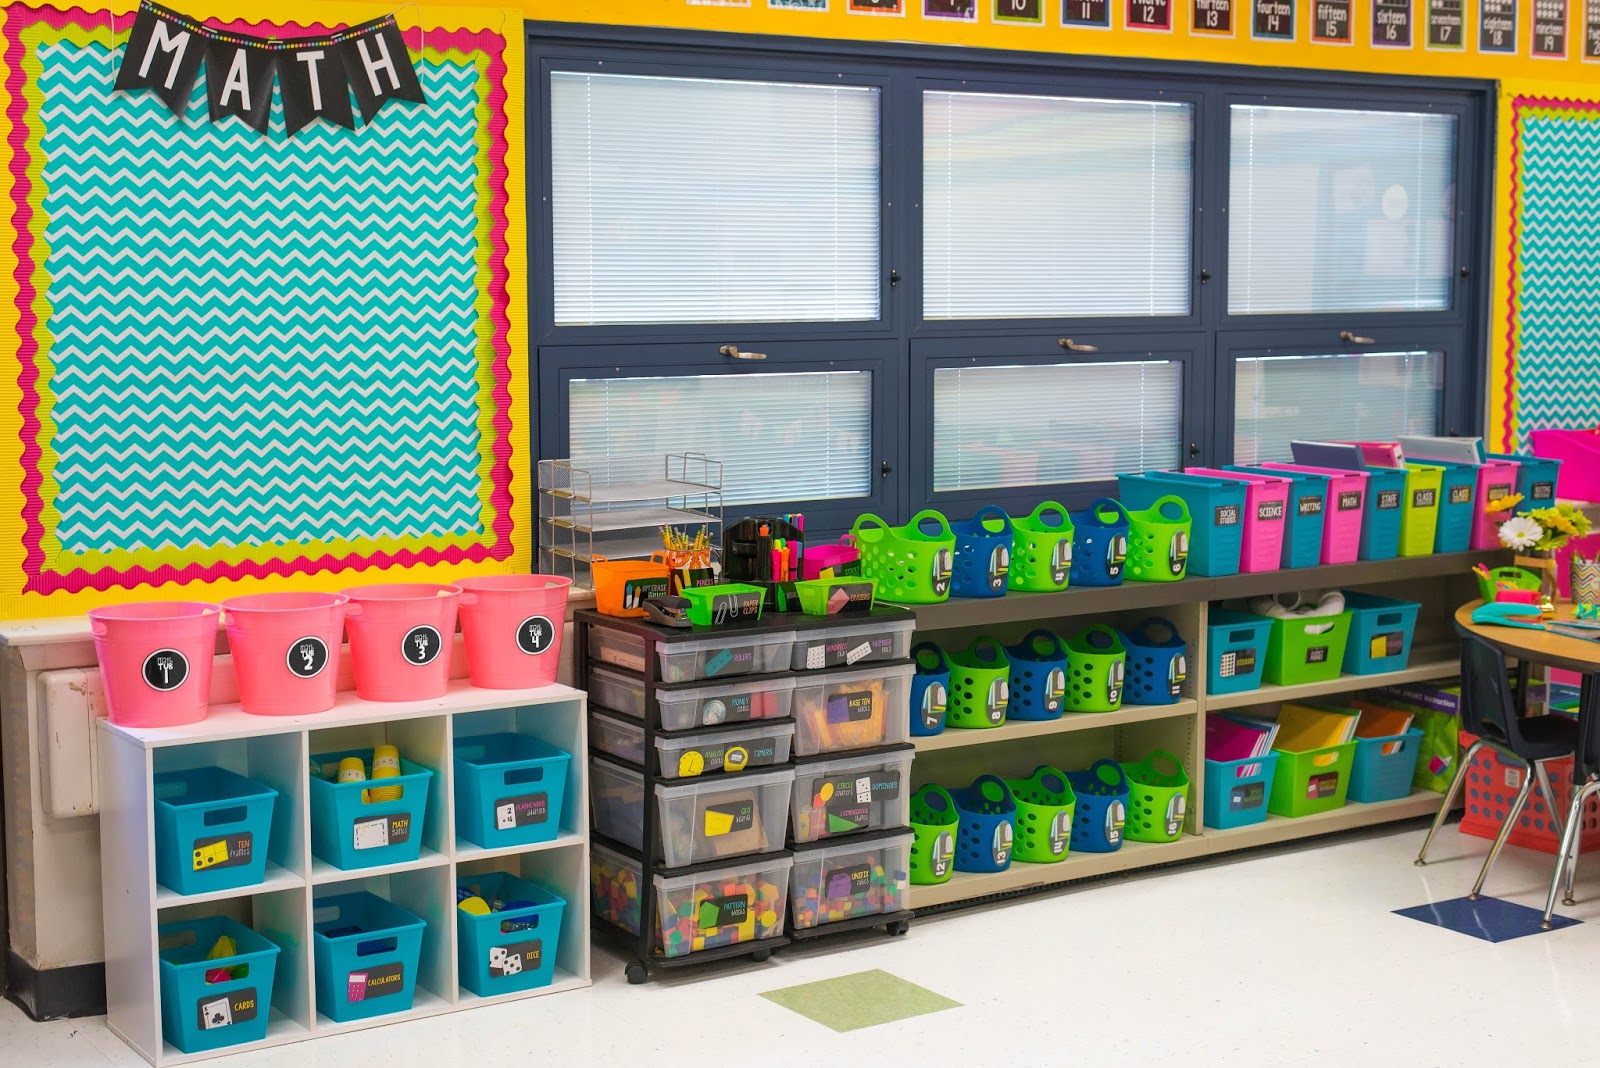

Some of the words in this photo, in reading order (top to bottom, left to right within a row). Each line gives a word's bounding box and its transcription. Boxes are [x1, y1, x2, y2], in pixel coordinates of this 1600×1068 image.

[1082, 2, 1090, 19] 11
[1257, 1, 1290, 16] fourteen
[1318, 4, 1347, 21] fifteen
[1143, 5, 1155, 23] 12
[1377, 9, 1406, 26] sixteen
[1206, 13, 1218, 27] 13
[1267, 15, 1279, 31] 14
[1430, 13, 1461, 26] seventeen
[1326, 21, 1337, 36] 15
[1483, 15, 1513, 35] eighteen
[1536, 23, 1563, 36] nineteen
[1386, 25, 1397, 40] 16
[1440, 27, 1450, 41] 17
[1492, 31, 1503, 46] 18
[1544, 35, 1554, 50] 19
[138, 20, 401, 111] MATH
[1381, 493, 1397, 504] STAFF
[1416, 491, 1433, 501] CLASS
[1452, 488, 1469, 499] CLASS
[1299, 502, 1322, 513] WRITING
[1342, 497, 1357, 508] MATH
[1219, 509, 1236, 518] SOCIAL
[1258, 506, 1282, 518] SCIENCE
[1219, 516, 1237, 525] STUDIES
[1110, 566, 1119, 575] 5
[1055, 572, 1064, 581] 4
[651, 584, 667, 592] ERASE
[696, 579, 714, 587] PENCILS
[936, 582, 946, 592] 2
[993, 579, 1002, 587] 3
[850, 593, 871, 602] ERASERS
[743, 600, 759, 608] PAPER
[743, 606, 758, 615] CLIPS
[529, 624, 542, 632] math
[532, 635, 540, 648] 4
[872, 639, 892, 648] NUMBER
[300, 644, 315, 652] math
[418, 645, 426, 660] 3
[301, 650, 315, 658] TUB
[734, 653, 752, 662] RULERS
[157, 656, 174, 664] math
[303, 655, 313, 671] 2
[1236, 657, 1255, 667] STICKERS
[164, 669, 169, 684] 1
[1172, 685, 1181, 694] 11
[1110, 690, 1118, 703] 10
[731, 698, 749, 707] MONEY
[849, 698, 861, 708] BASE
[861, 697, 871, 706] TEN
[926, 716, 938, 725] 7
[991, 711, 1001, 720] 8
[705, 749, 724, 759] ANALOG
[753, 748, 773, 758] TIMERS
[838, 781, 854, 789] CIRCLE
[872, 781, 897, 790] DOMINOES
[516, 800, 546, 810] FLASHCARDS
[741, 807, 751, 815] GEO
[392, 819, 409, 829] MATH
[1168, 822, 1177, 835] 16
[1110, 830, 1119, 843] 15
[237, 840, 250, 849] TEN
[1053, 840, 1063, 854] 14
[996, 851, 1006, 864] 13
[936, 861, 946, 876] 12
[851, 870, 869, 880] UNIFIX
[724, 901, 746, 911] PATTERN
[526, 951, 540, 960] DICE
[367, 974, 401, 987] CALCULATORS
[234, 1000, 255, 1011] CARDS
